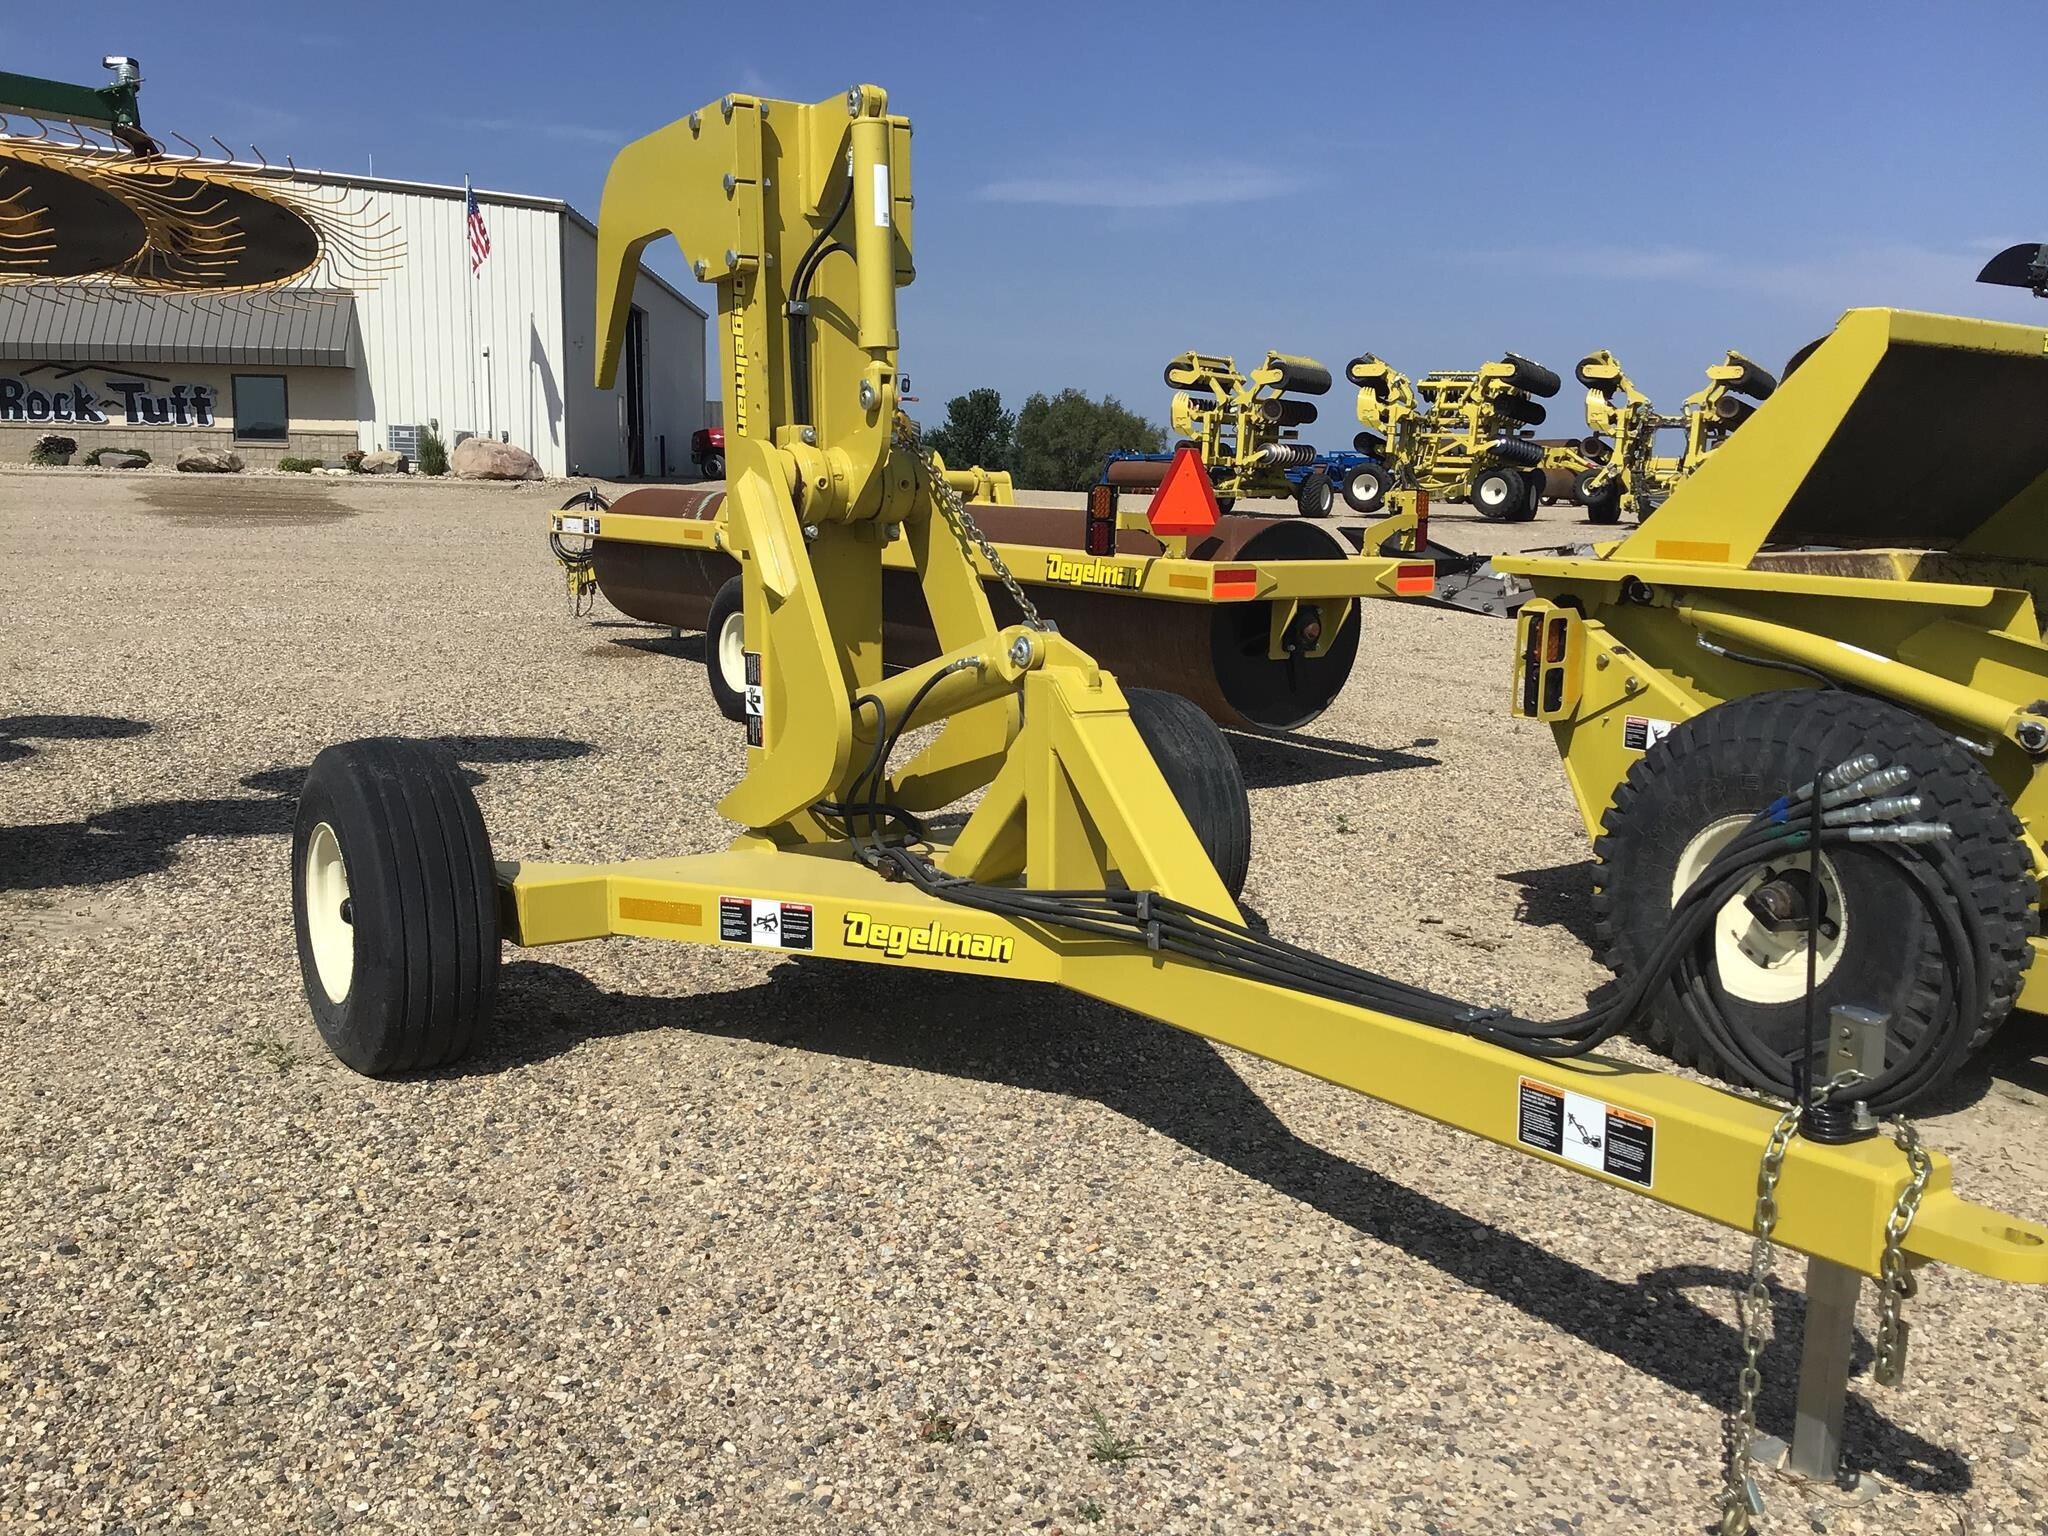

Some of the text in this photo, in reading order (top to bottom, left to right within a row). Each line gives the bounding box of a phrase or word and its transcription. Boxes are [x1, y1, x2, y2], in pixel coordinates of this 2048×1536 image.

[731, 276, 749, 438] Degelman
[0, 377, 215, 427] Rock Tuff
[1046, 553, 1143, 589] Degelman
[843, 911, 1015, 963] Degelman
